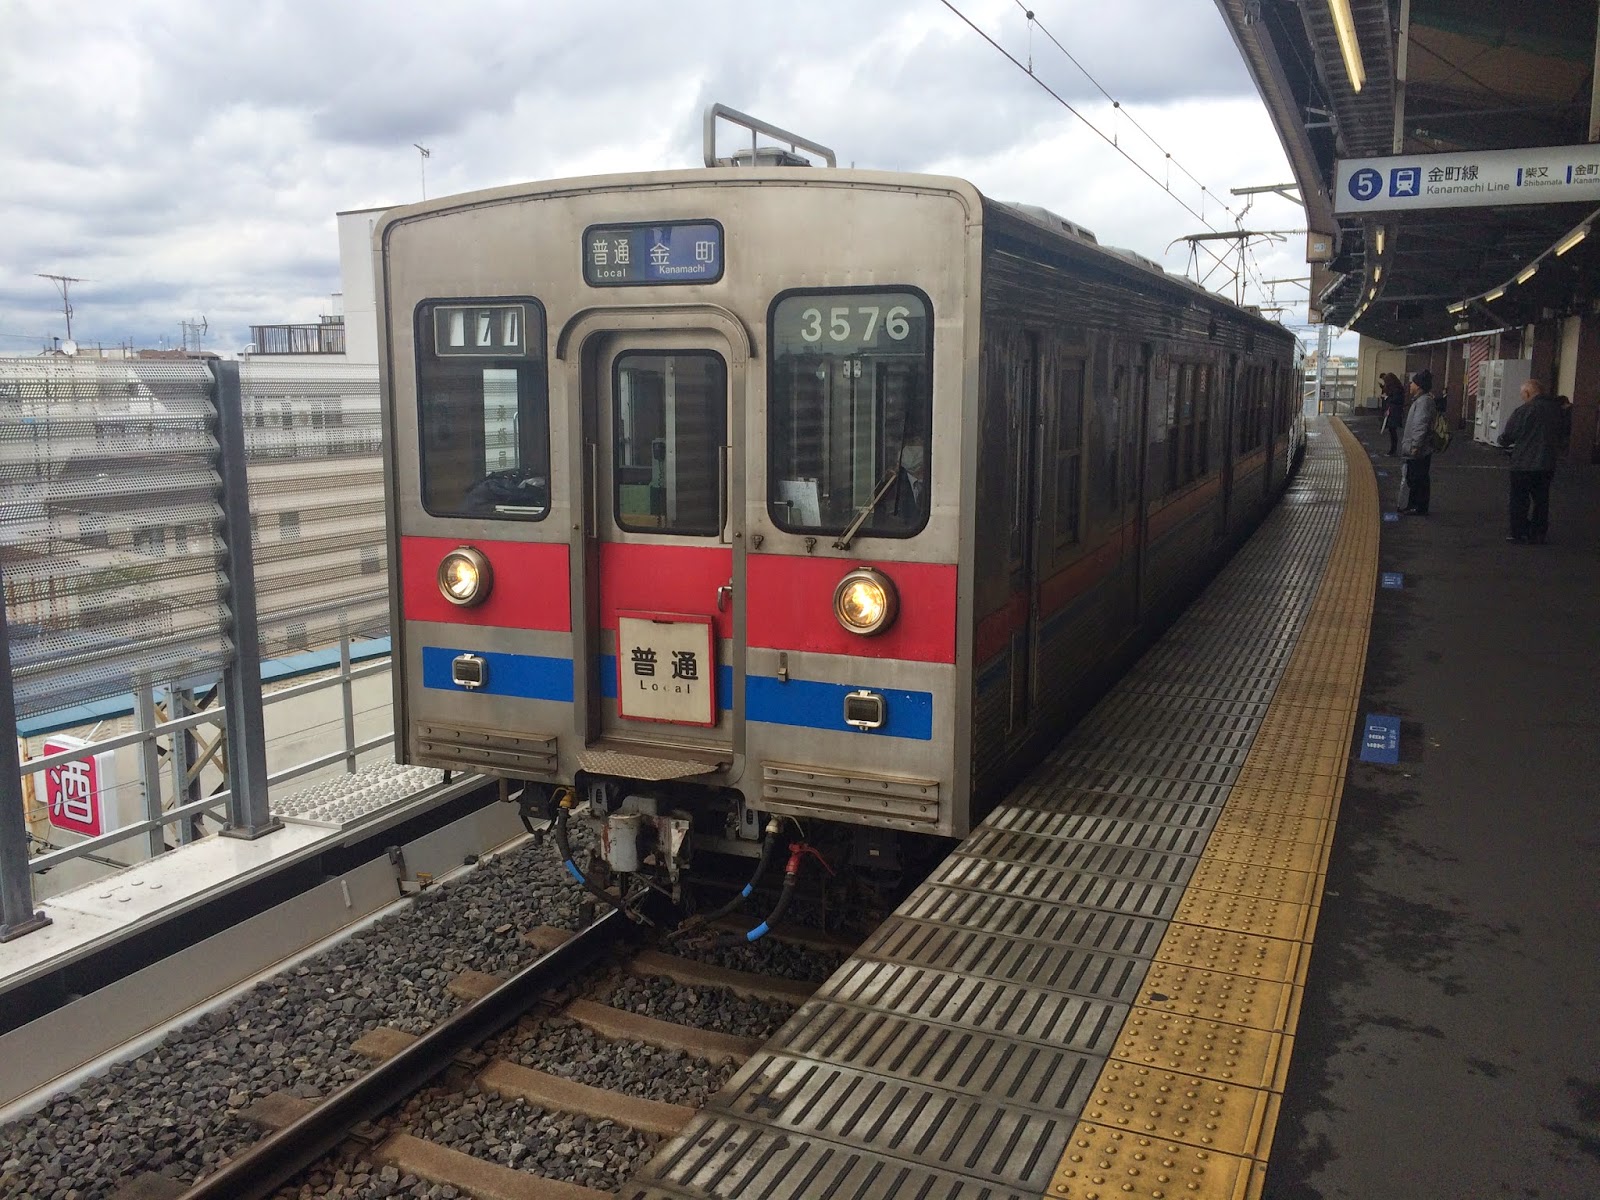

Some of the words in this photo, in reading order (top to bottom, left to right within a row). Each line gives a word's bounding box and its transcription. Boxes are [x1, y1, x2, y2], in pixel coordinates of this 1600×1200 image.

[1428, 165, 1479, 183] 金町線
[1525, 166, 1549, 178] 柴又
[1574, 164, 1600, 176] 金町
[1357, 173, 1373, 196] 5
[1426, 182, 1485, 195] Kanamachi
[1487, 182, 1510, 192] Line
[1523, 178, 1563, 187] Shibamata
[593, 239, 630, 265] 普通
[597, 268, 626, 278] Local
[659, 265, 706, 274] Kanamachi
[801, 306, 910, 342] 3576
[631, 646, 699, 680] 普通
[50, 760, 93, 824] 酒
